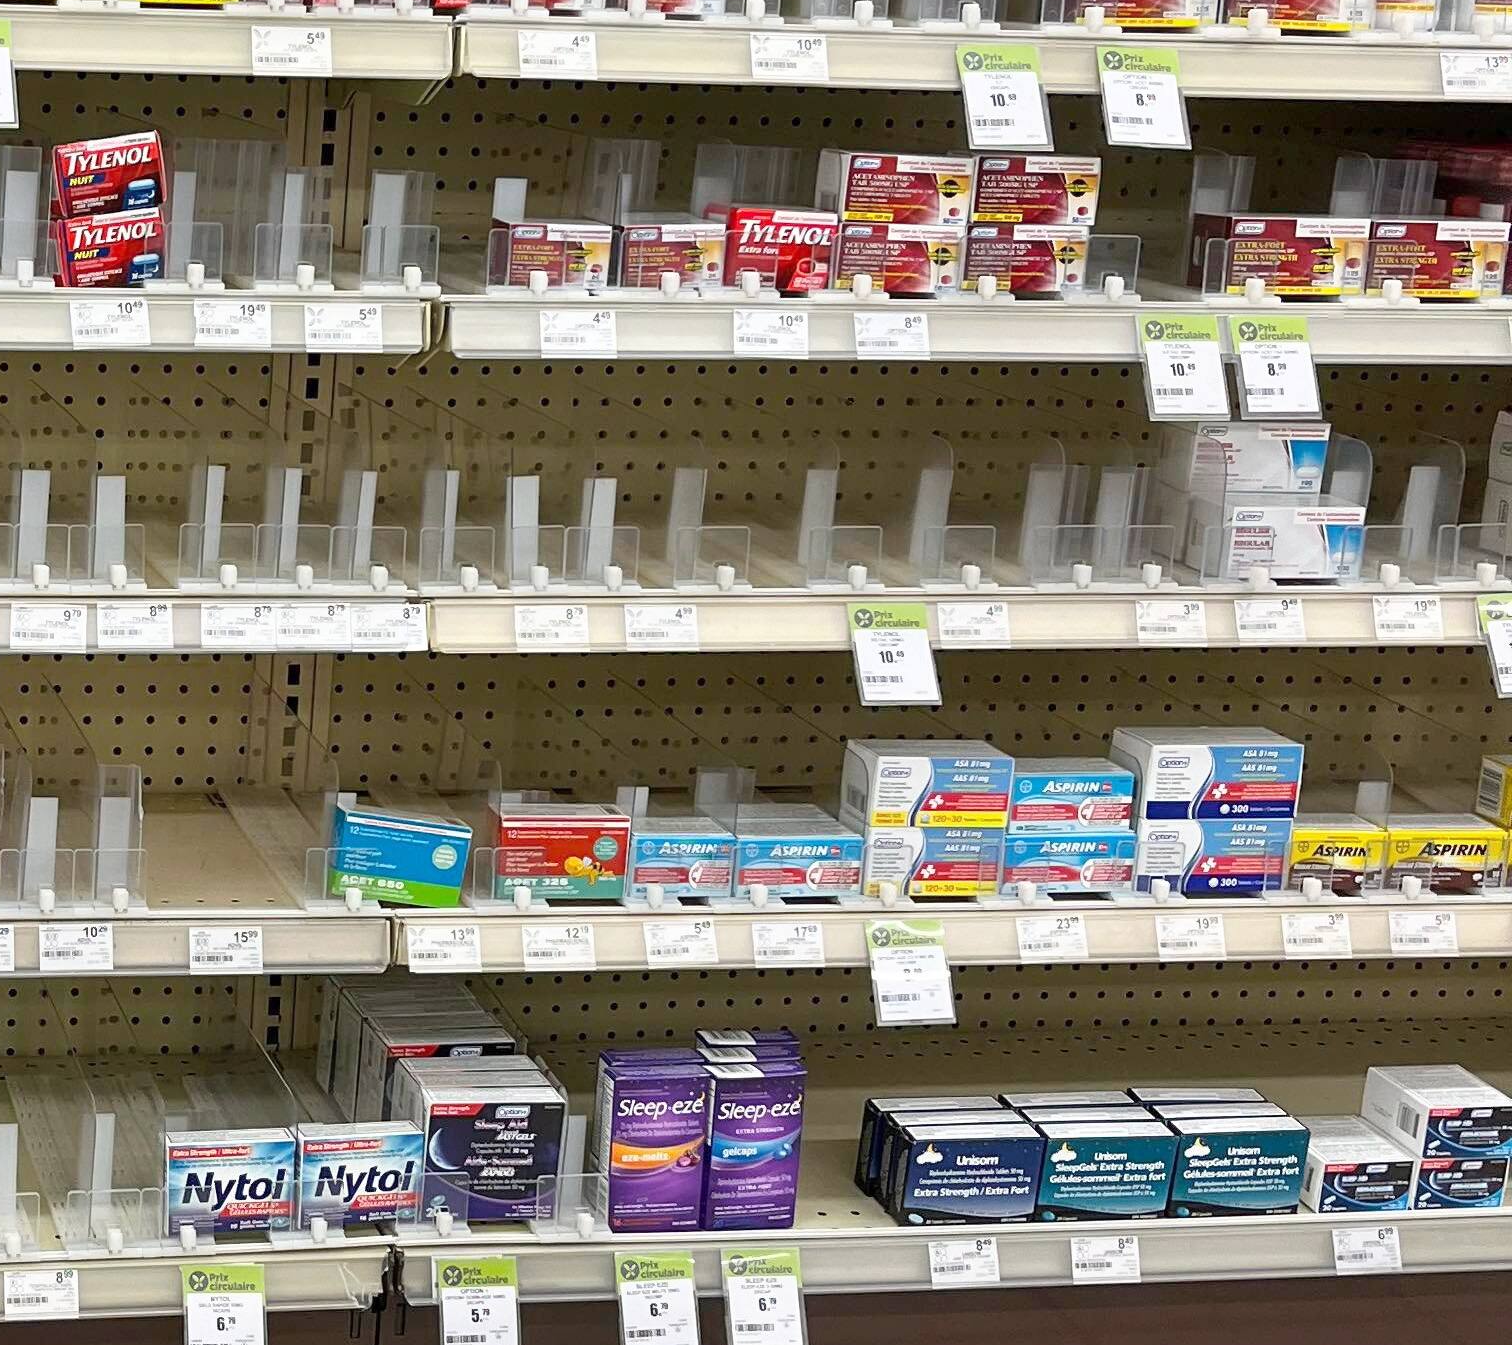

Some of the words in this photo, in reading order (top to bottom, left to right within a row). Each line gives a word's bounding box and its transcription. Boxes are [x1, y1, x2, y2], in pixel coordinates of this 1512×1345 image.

[63, 144, 153, 177] TYLENOL
[69, 175, 95, 186] NUIT
[69, 219, 158, 251] TYLENOL
[737, 219, 834, 248] TYLENOL
[73, 249, 100, 260] NUIT
[1164, 322, 1185, 333] Prix
[1166, 330, 1212, 341] circulaire
[1042, 780, 1101, 794] ASPIRIN
[1231, 804, 1249, 814] 300
[658, 841, 718, 856] ASPIRIN
[770, 843, 828, 858] ASPIRIN
[1313, 842, 1369, 857] ASPIRIN
[1420, 841, 1488, 857] ASPIRIN
[341, 875, 375, 886] ACET
[505, 877, 540, 887] ACET
[722, 1146, 758, 1158] gelcaps
[1094, 1151, 1128, 1162] Unisom
[1227, 1145, 1261, 1156] Unisom
[956, 1154, 999, 1167] Unisom
[1100, 1161, 1122, 1171] Extra
[1124, 1160, 1164, 1173] Strength
[315, 1160, 415, 1204] Nytol
[1123, 1172, 1145, 1183] Extra
[1147, 1171, 1166, 1182] fort
[182, 1168, 288, 1212] Nytol
[914, 1186, 939, 1197] Extra
[941, 1186, 979, 1198] Strength
[986, 1185, 1009, 1196] Extra
[1010, 1185, 1029, 1195] Fort
[747, 1265, 793, 1275] circulaire
[208, 1273, 230, 1282] Prix
[208, 1280, 257, 1291] circulaire
